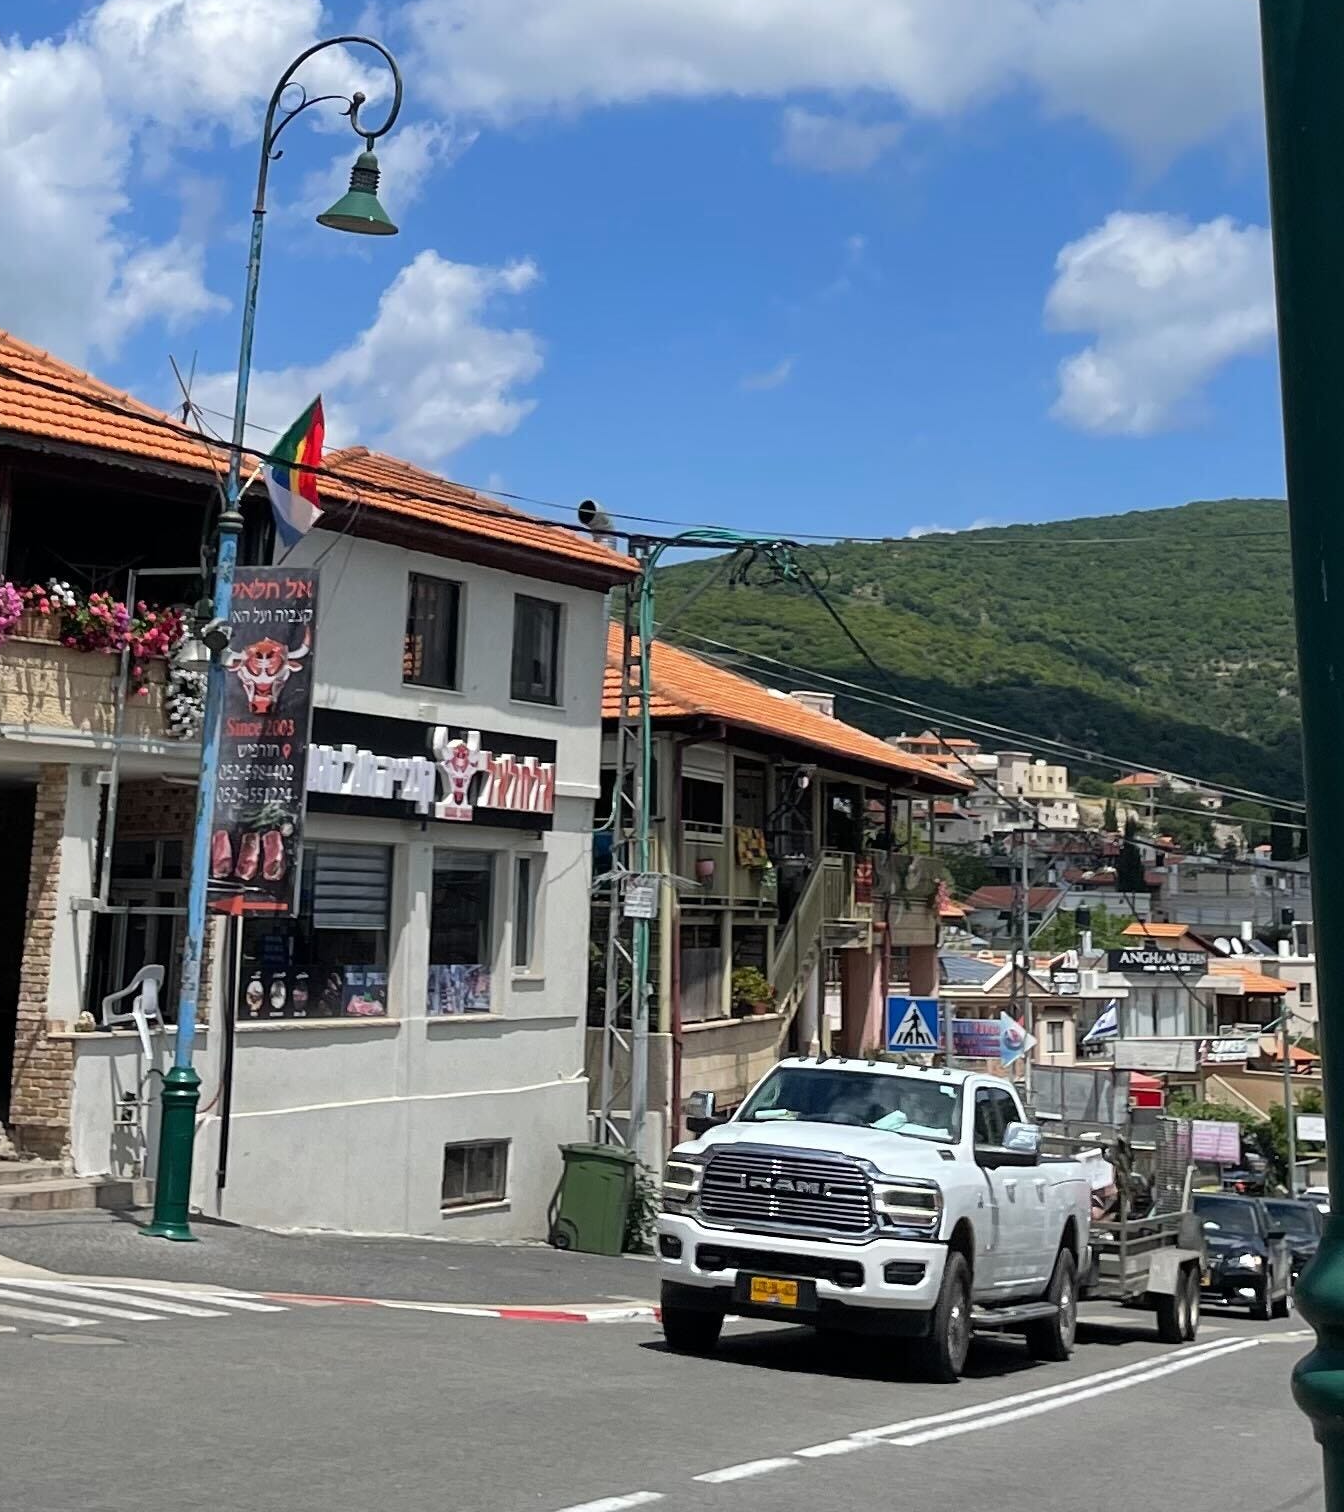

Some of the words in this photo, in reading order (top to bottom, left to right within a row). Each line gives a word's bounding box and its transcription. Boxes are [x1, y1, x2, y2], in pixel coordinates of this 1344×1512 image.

[284, 576, 313, 599] אל
[232, 609, 251, 624] הא
[274, 608, 314, 625] קצביה
[226, 717, 262, 736] Since
[264, 719, 295, 736] 2003
